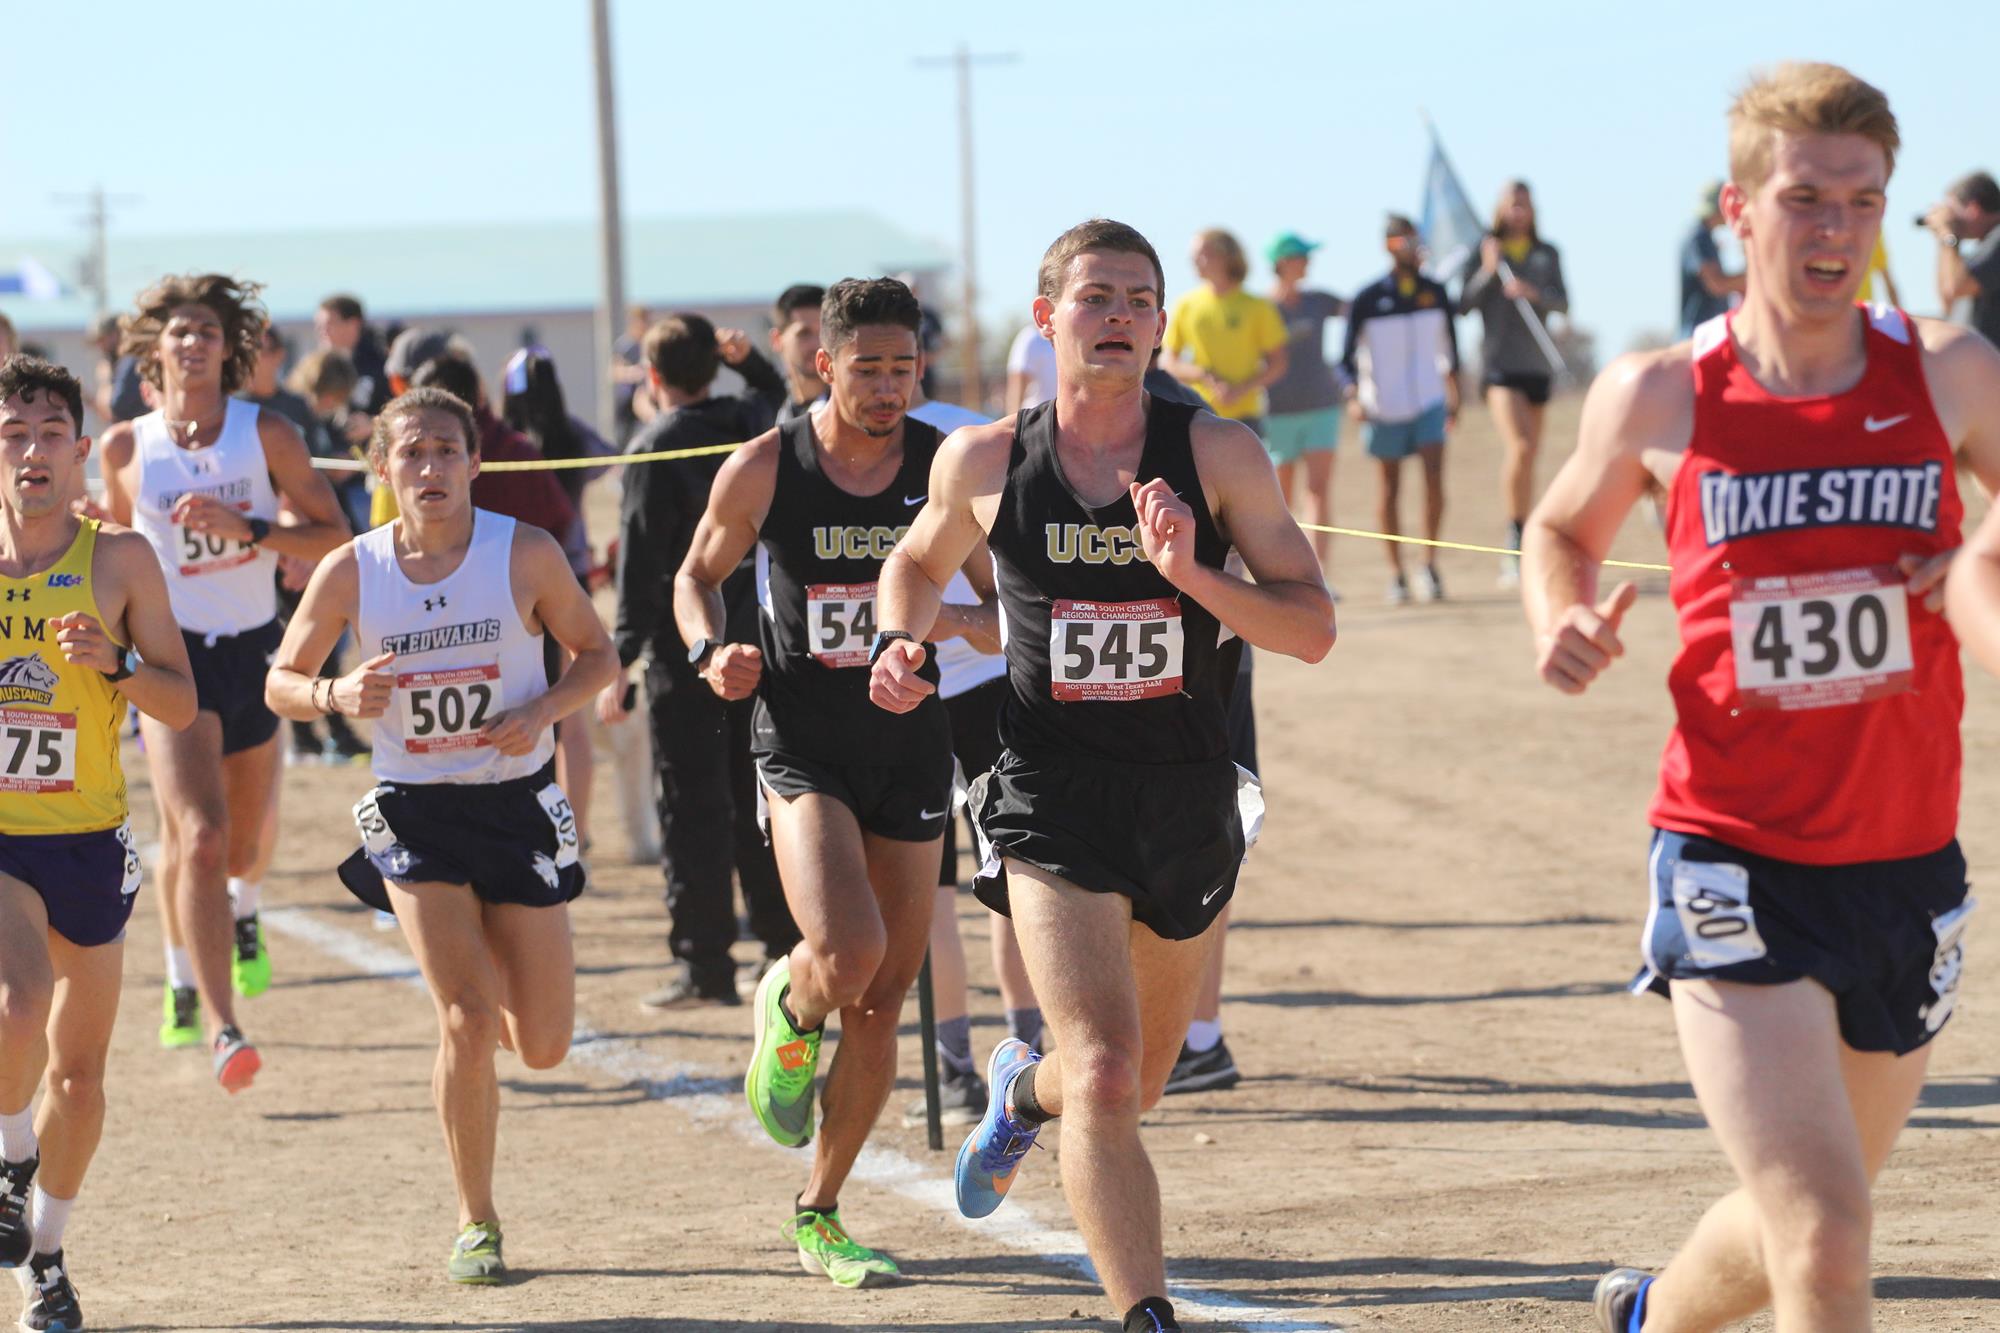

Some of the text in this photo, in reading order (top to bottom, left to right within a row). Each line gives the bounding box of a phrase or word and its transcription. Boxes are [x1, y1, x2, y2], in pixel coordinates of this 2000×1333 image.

[1701, 462, 1942, 546] DIXIE STATE
[1061, 611, 1165, 621] REGIONAL CHAMPIONSHIPS
[1072, 602, 1160, 613] NCAA SOUTH CENTRAL
[1064, 621, 1169, 680] 545
[1752, 594, 1889, 679] 430
[8, 719, 62, 728] CHAMPIONSHIPS
[410, 684, 493, 736] 502
[0, 727, 63, 776] 75
